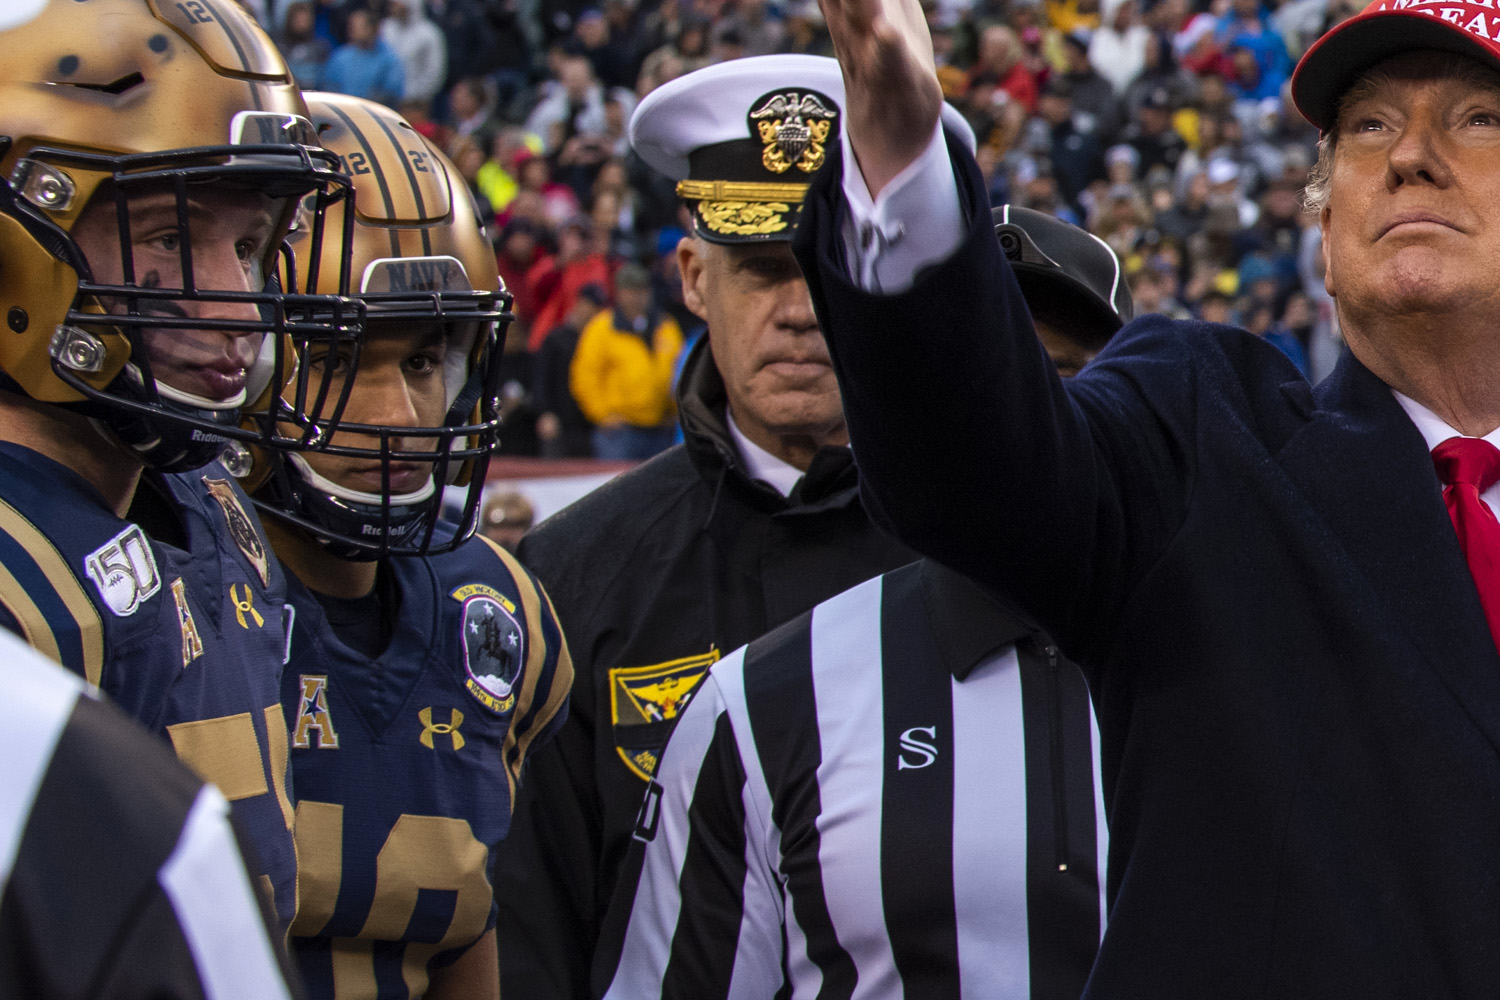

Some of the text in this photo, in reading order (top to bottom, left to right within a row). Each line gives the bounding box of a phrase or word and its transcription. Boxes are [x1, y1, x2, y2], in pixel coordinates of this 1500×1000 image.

[176, 1, 213, 24] 12
[340, 152, 371, 176] 12
[386, 261, 449, 293] NAVY
[87, 527, 161, 614] 150
[292, 675, 339, 749] A
[898, 725, 938, 771] S
